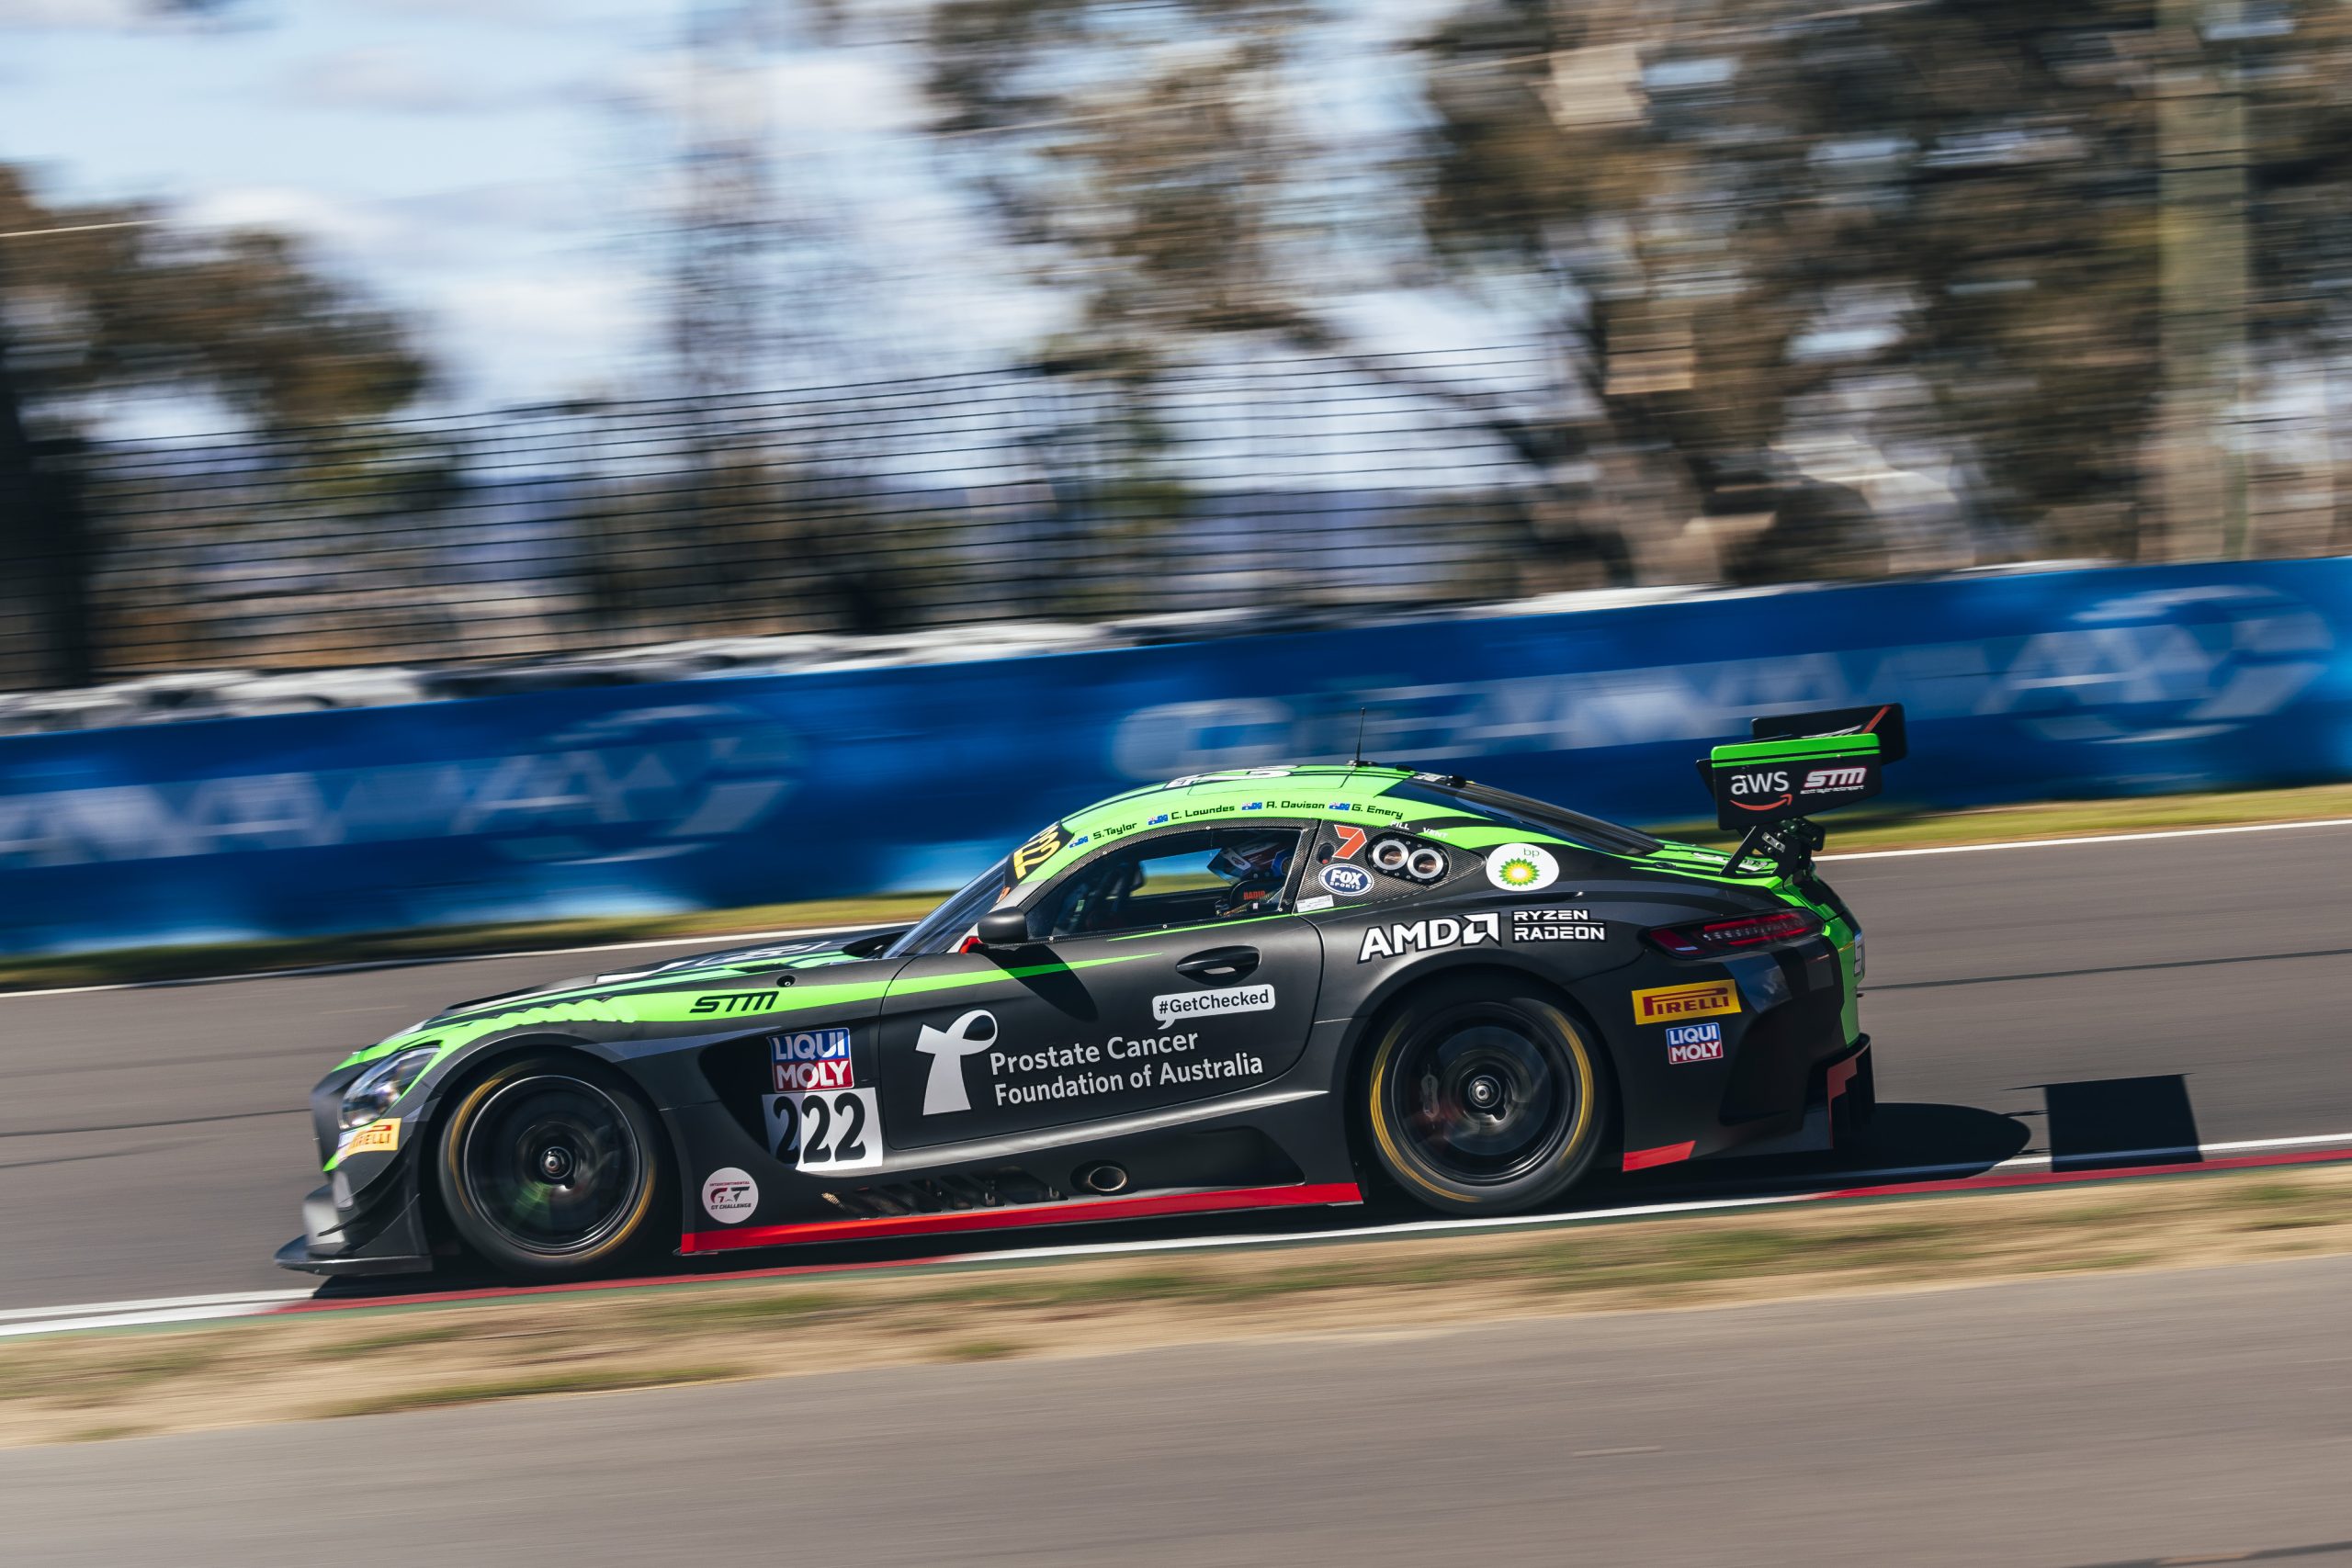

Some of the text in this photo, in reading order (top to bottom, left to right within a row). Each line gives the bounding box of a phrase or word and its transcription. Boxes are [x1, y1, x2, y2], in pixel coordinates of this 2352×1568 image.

[1731, 772, 1790, 795] aws
[1804, 767, 1867, 788] STM
[1171, 805, 1235, 820] C. Lowndes
[1281, 800, 1325, 809] Davison
[1351, 804, 1403, 820] G. Emery
[1332, 824, 1368, 860] 7
[1523, 848, 1540, 858] bp
[1329, 882, 1361, 890] SPORTS
[1331, 869, 1362, 886] FOX
[1513, 909, 1589, 921] RYZEN
[1360, 919, 1461, 961] AMD
[1514, 926, 1605, 941] RADEON
[689, 991, 779, 1013] STM
[1159, 988, 1270, 1014] #GetChecked
[1642, 987, 1730, 1017] PIRELLI
[1669, 1024, 1718, 1045] LIQUI
[772, 1031, 846, 1061] LIQUI
[989, 1032, 1198, 1076] Prostate Cancer
[1671, 1041, 1720, 1062] MOLY
[775, 1060, 849, 1089] MOLY
[994, 1053, 1263, 1106] Foundation of Australia
[773, 1092, 866, 1165] 222
